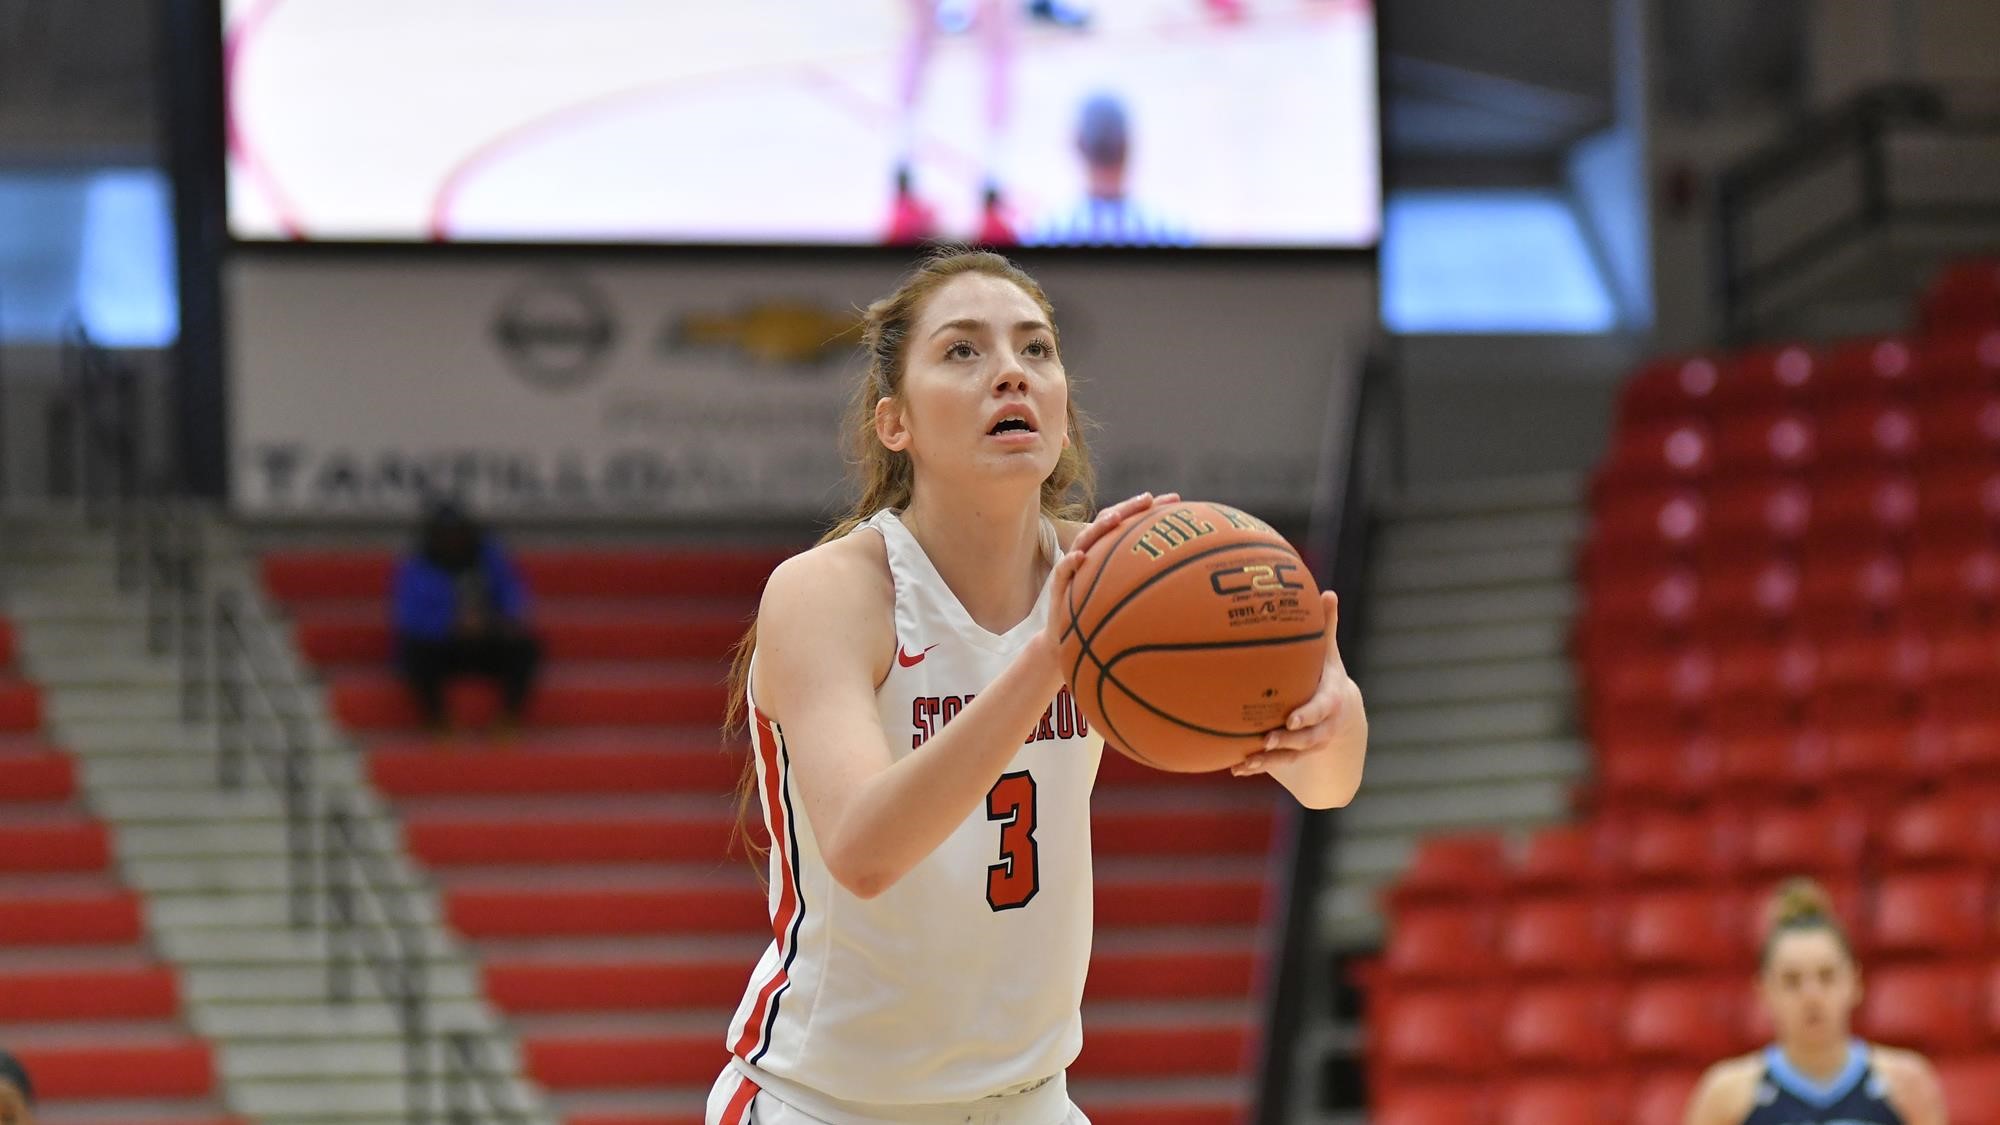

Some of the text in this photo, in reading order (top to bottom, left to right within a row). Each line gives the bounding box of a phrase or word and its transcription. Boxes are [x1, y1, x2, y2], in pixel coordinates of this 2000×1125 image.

[1132, 507, 1217, 561] THE
[1210, 564, 1304, 595] C2C
[986, 769, 1040, 913] 3
